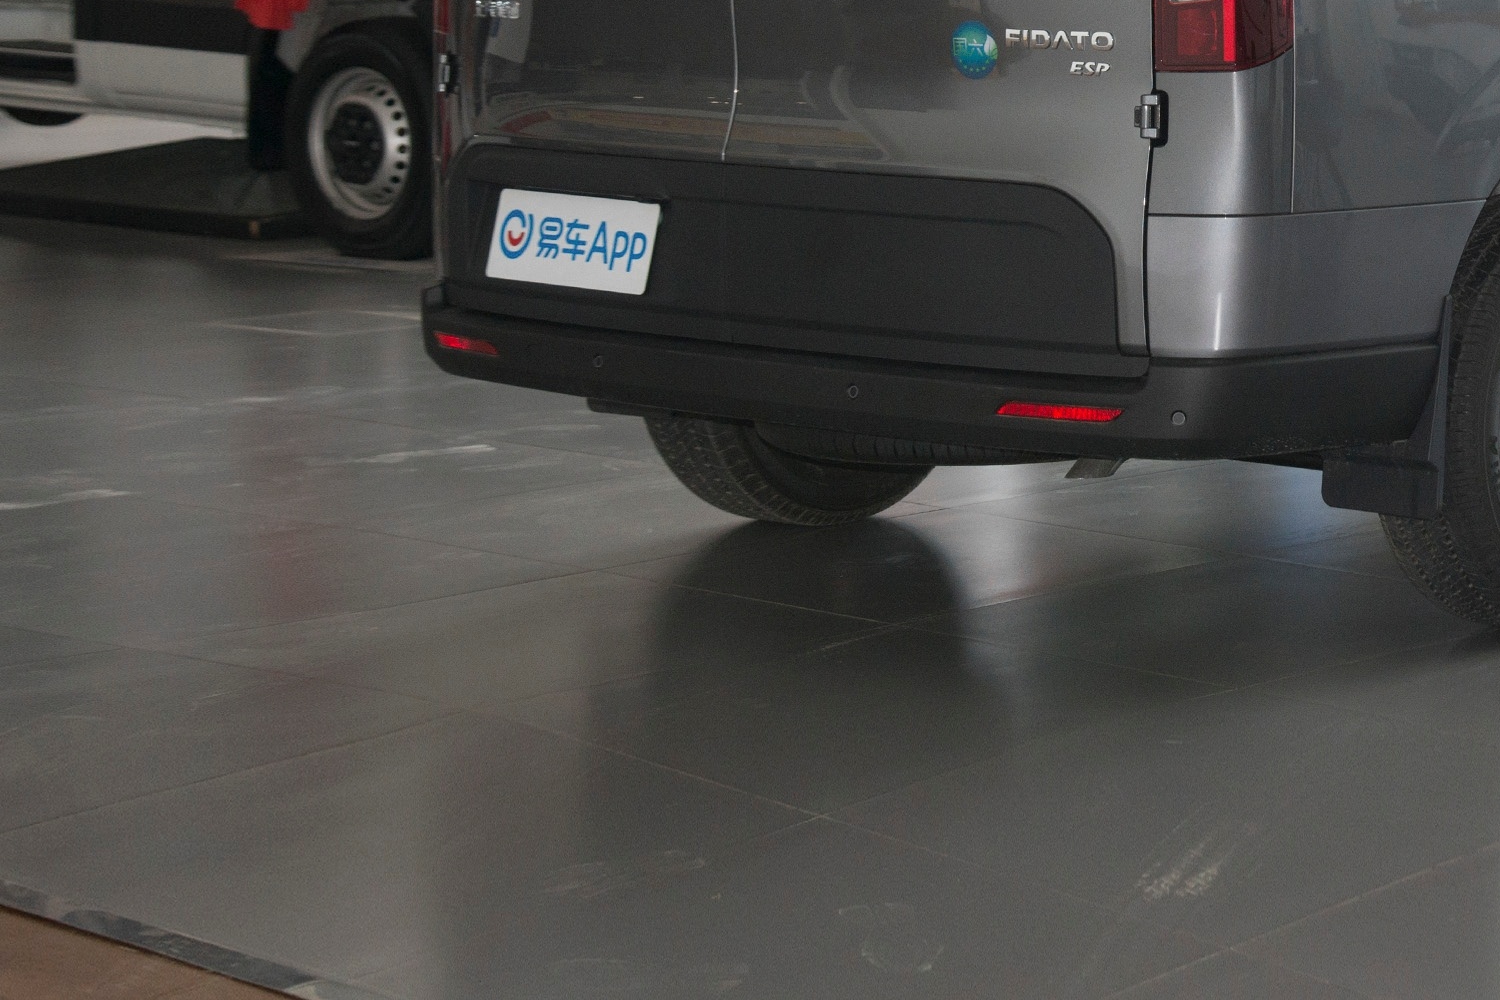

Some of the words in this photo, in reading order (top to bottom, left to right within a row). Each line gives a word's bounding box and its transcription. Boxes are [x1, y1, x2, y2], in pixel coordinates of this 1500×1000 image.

[1005, 28, 1116, 51] FIDATO
[1069, 61, 1112, 77] ESP
[535, 216, 648, 272] 易车App
